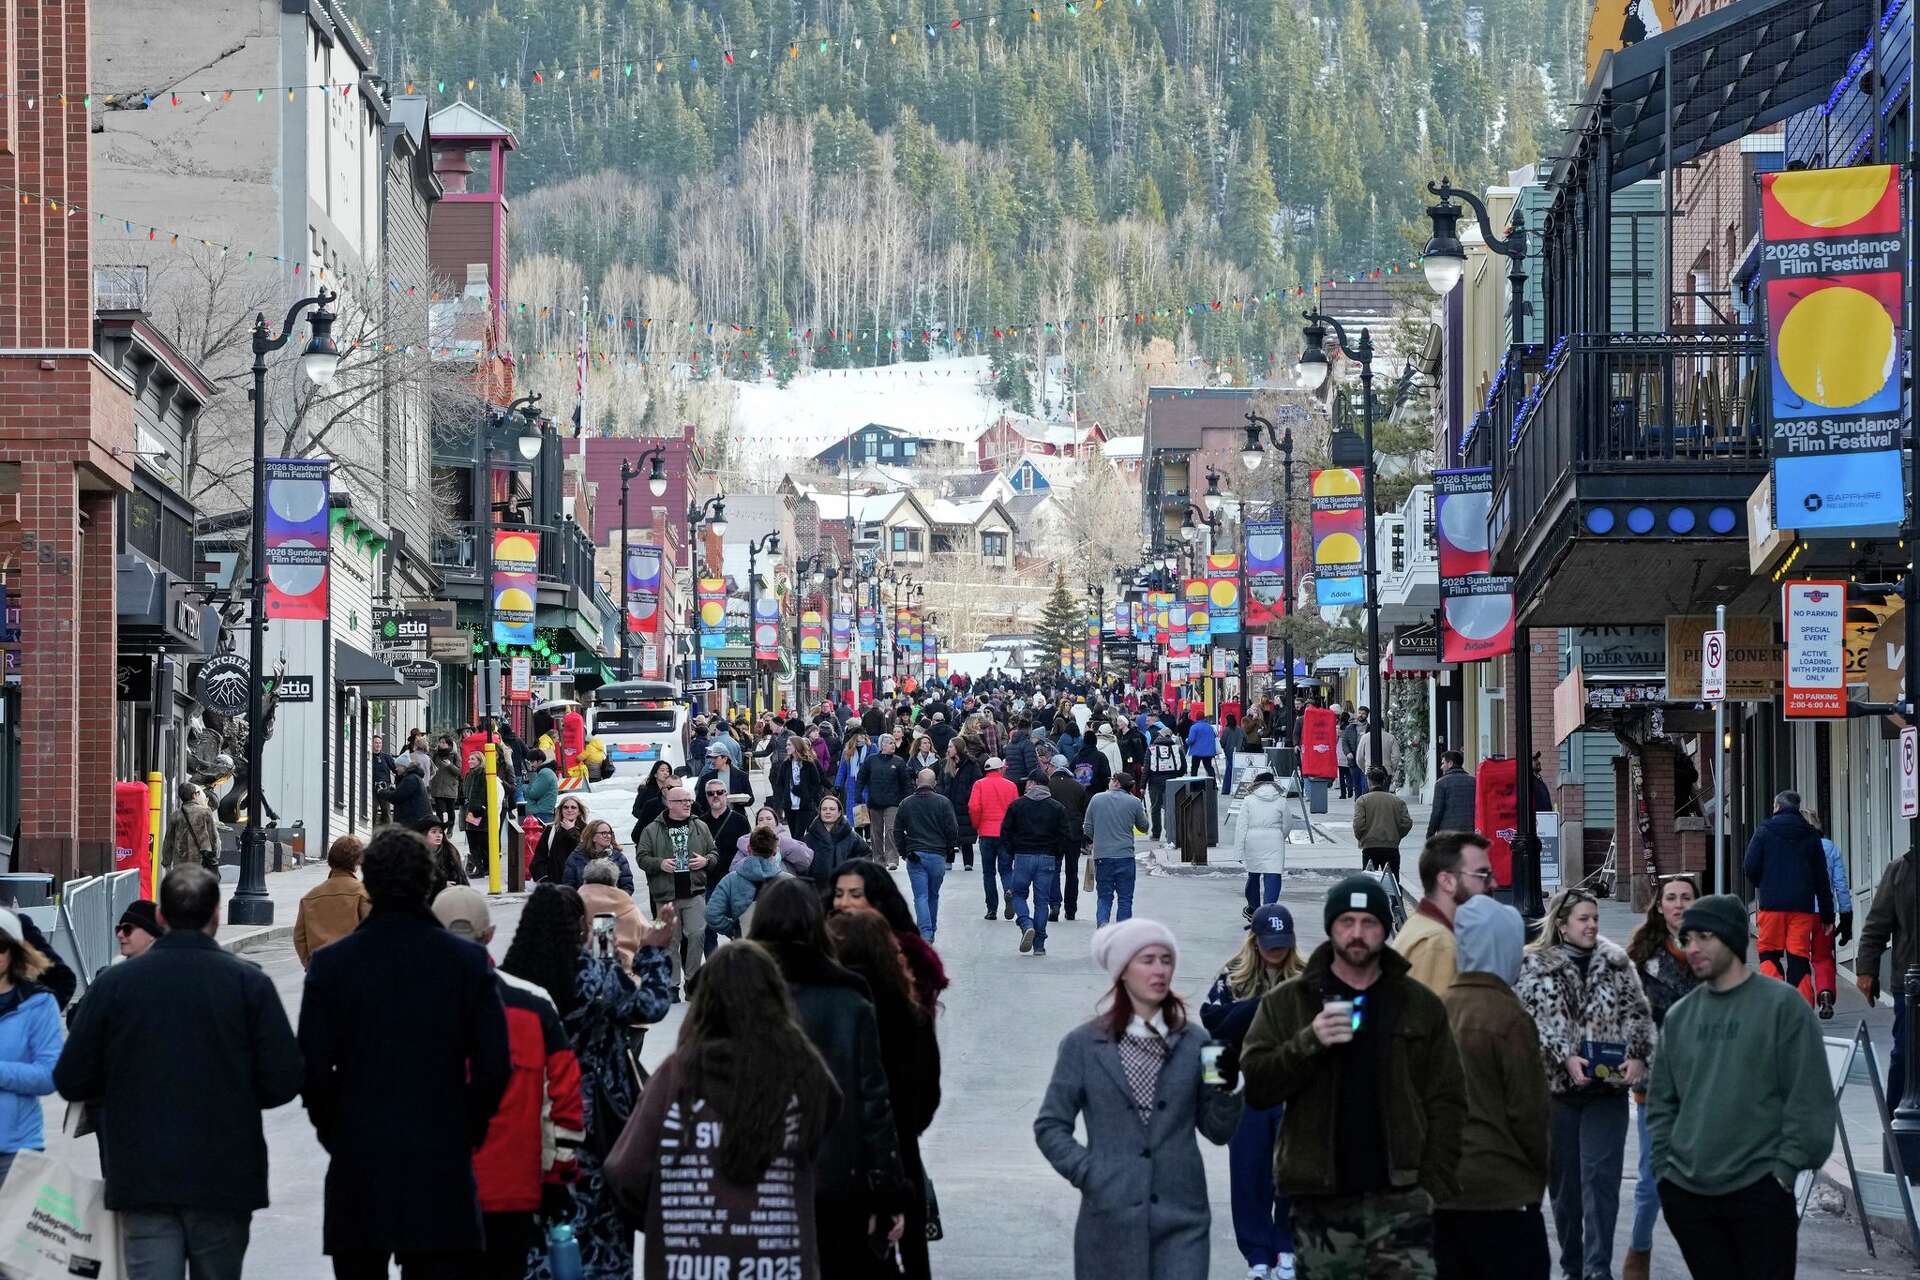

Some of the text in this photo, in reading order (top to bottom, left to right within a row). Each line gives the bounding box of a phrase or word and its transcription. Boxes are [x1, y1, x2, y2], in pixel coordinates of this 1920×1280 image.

[1766, 239, 1901, 260] 2026 Sundance
[1780, 253, 1889, 275] Film Festival
[1774, 417, 1900, 438] 2026 Sundance
[1788, 431, 1892, 452] Film Festival
[288, 464, 328, 472] Sundance
[272, 470, 322, 479] Film Festival
[1435, 473, 1492, 485] 2026 Sunda
[1443, 482, 1492, 493] Film Festiv
[287, 549, 327, 557] Sundance
[290, 556, 321, 564] Festival
[1442, 575, 1514, 587] 2026 Sundance
[1449, 583, 1507, 595] Film Festival
[398, 621, 427, 634] stio
[1400, 638, 1437, 646] OVER
[1464, 641, 1495, 651] Adobe
[1584, 652, 1665, 664] DEER VALL
[198, 656, 250, 680] FLETCHER
[280, 681, 310, 694] stio
[1268, 917, 1284, 930] TB
[665, 1254, 801, 1280] TOUR 2025
